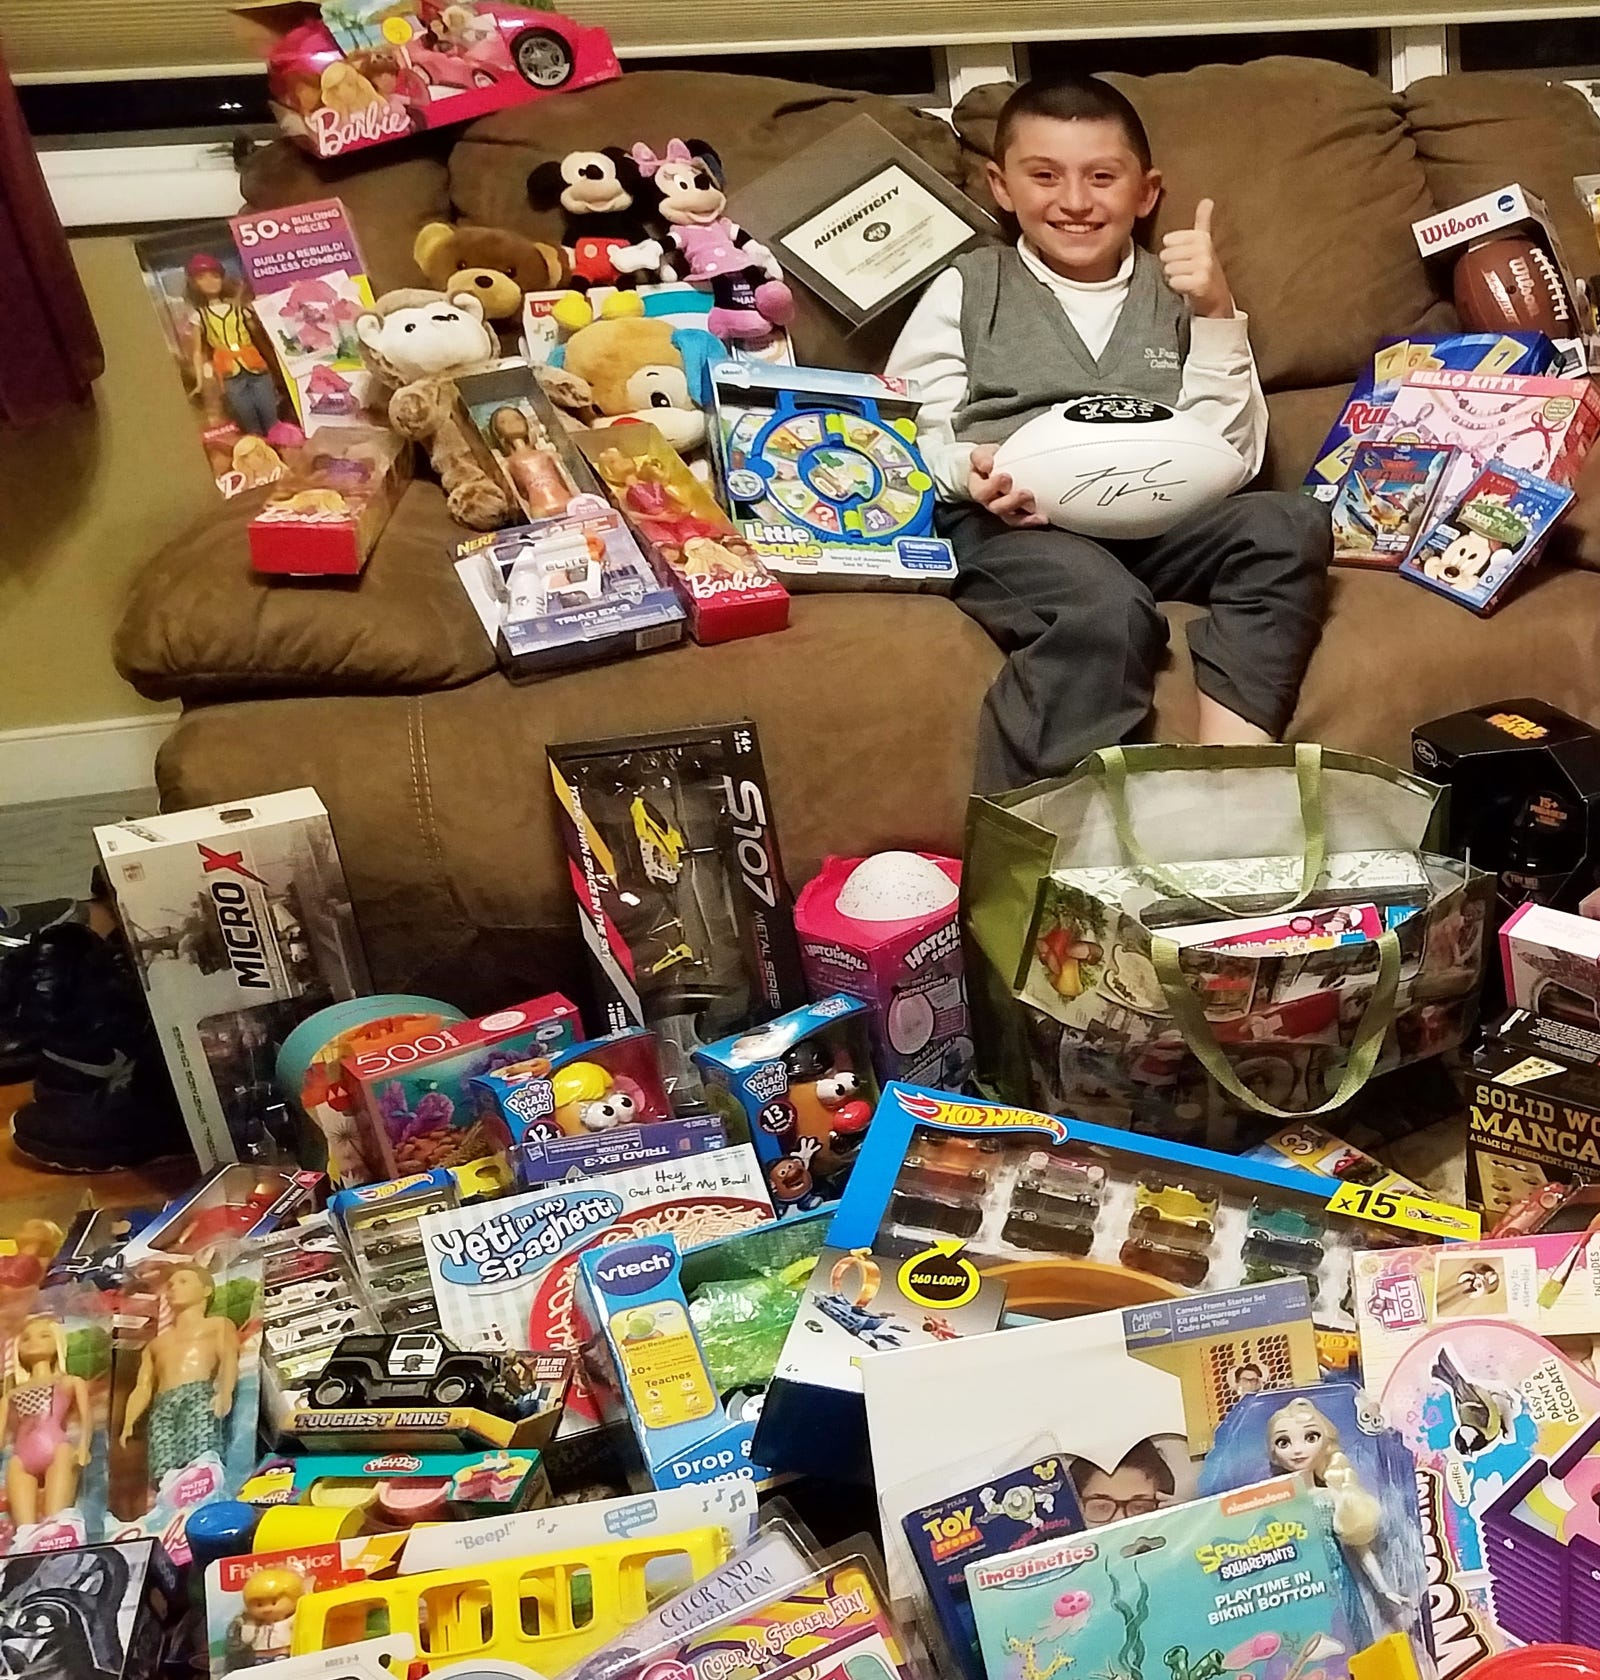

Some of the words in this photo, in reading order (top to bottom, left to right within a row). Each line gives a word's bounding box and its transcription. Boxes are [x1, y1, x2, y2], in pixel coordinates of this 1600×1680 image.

[310, 104, 411, 156] Barbie
[291, 208, 340, 225] BUILDING
[294, 221, 331, 235] PIECES
[813, 186, 900, 249] AUTHENTICITY
[1419, 211, 1490, 245] Wilson
[239, 220, 291, 246] 50+
[253, 253, 285, 267] BUILD
[298, 242, 345, 258] REBUILD!
[253, 261, 300, 279] ENDLESS
[302, 252, 352, 268] COMBOS!
[1508, 256, 1541, 317] Wilson
[1410, 370, 1466, 387] HELLO
[1468, 375, 1529, 391] KITTY
[456, 533, 497, 556] NERF
[743, 521, 810, 544] Little
[686, 572, 776, 600] Barbie
[555, 611, 597, 625] TRIAD
[740, 730, 751, 753] 14+
[721, 775, 776, 908] S107
[196, 842, 269, 888] X
[211, 880, 271, 991] MICRO
[754, 911, 770, 958] METAL
[765, 958, 782, 1010] SERIES
[746, 1065, 786, 1093] Potato
[758, 1083, 785, 1100] Head
[508, 1085, 550, 1111] Potato
[522, 1101, 550, 1119] Head
[1476, 1085, 1554, 1122] SOLID
[763, 1105, 784, 1125] 13
[936, 1103, 986, 1127] HOT
[529, 1125, 552, 1143] 12
[1477, 1135, 1500, 1150] GAME
[584, 1153, 620, 1167] EX-3
[622, 1146, 669, 1161] TRIAD
[628, 1186, 653, 1199] Get
[655, 1184, 680, 1197] Out
[696, 1178, 718, 1193] My
[720, 1173, 752, 1189] Bowl!
[1336, 1188, 1401, 1220] x15
[434, 1213, 518, 1266] Yeti
[517, 1214, 535, 1233] in
[536, 1198, 566, 1219] My
[479, 1197, 619, 1285] Spaghetti
[598, 1254, 672, 1282] vtech
[910, 1273, 931, 1285] 360
[932, 1274, 967, 1287] LOOP!
[1175, 1303, 1202, 1316] Canvas
[1203, 1300, 1226, 1312] Frame
[1227, 1296, 1253, 1309] Starter
[1254, 1293, 1267, 1304] Set
[1377, 1282, 1397, 1322] EZ
[1400, 1281, 1416, 1321] BOLT
[1132, 1309, 1163, 1323] Artist's
[1132, 1320, 1152, 1333] Loft
[1177, 1323, 1199, 1334] Cadre
[1211, 1317, 1230, 1328] Toile
[644, 1371, 691, 1388] Teaches
[1542, 1358, 1579, 1422] DECORATE!
[1538, 1382, 1563, 1420] PAINT
[296, 1412, 391, 1428] TOUGHEST
[396, 1411, 450, 1426] MINIS
[367, 1456, 421, 1472] Play-Doh
[673, 1449, 729, 1480] Drop
[180, 1479, 210, 1490] WATER
[181, 1487, 209, 1499] PLAY!
[1226, 1489, 1292, 1515] nickelodeon
[921, 1505, 974, 1541] TOY
[935, 1533, 979, 1558] STORY
[1196, 1520, 1308, 1573] SpongeBob
[229, 1554, 335, 1581] FishPrice
[978, 1544, 1097, 1587] imaginetics
[1220, 1545, 1296, 1581] SQUAREPANTS
[658, 1584, 714, 1629] COLOR
[719, 1558, 757, 1595] AND
[734, 1568, 777, 1605] FUN!
[1214, 1578, 1291, 1609] PLAYTIME
[1295, 1570, 1312, 1588] IN
[1207, 1602, 1254, 1627] BIKINI
[1257, 1581, 1326, 1613] BOTTOM
[700, 1647, 749, 1680] COLOR
[765, 1612, 829, 1654] STICKER
[825, 1588, 869, 1624] FUN!
